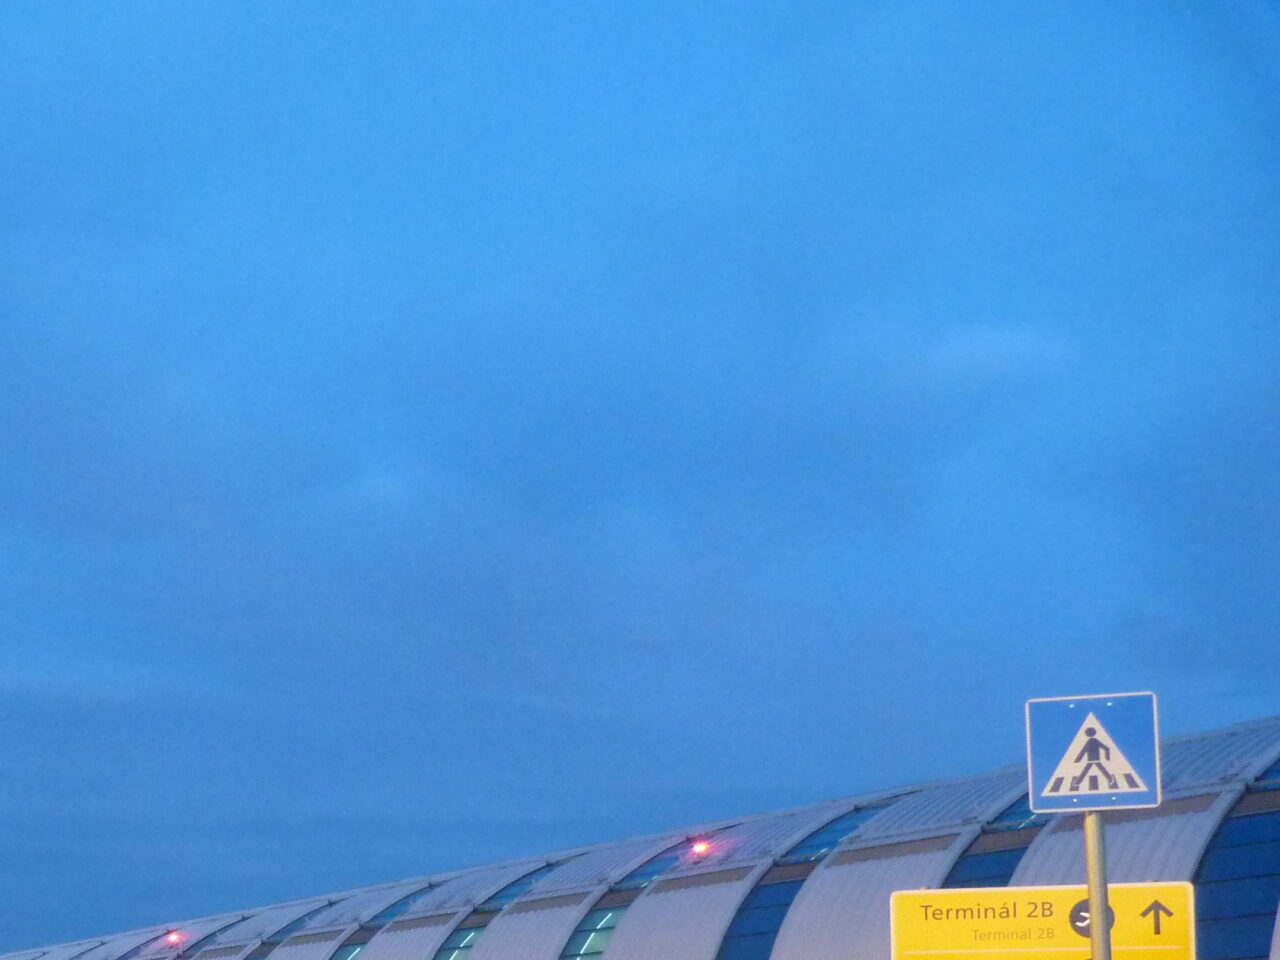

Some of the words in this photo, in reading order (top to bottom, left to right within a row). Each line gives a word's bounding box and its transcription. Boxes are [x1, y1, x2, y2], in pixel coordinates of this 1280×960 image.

[920, 901, 1017, 921] Terminál
[1027, 901, 1054, 918] 2B
[972, 928, 1032, 941] Terminal
[1037, 927, 1055, 939] 2B
